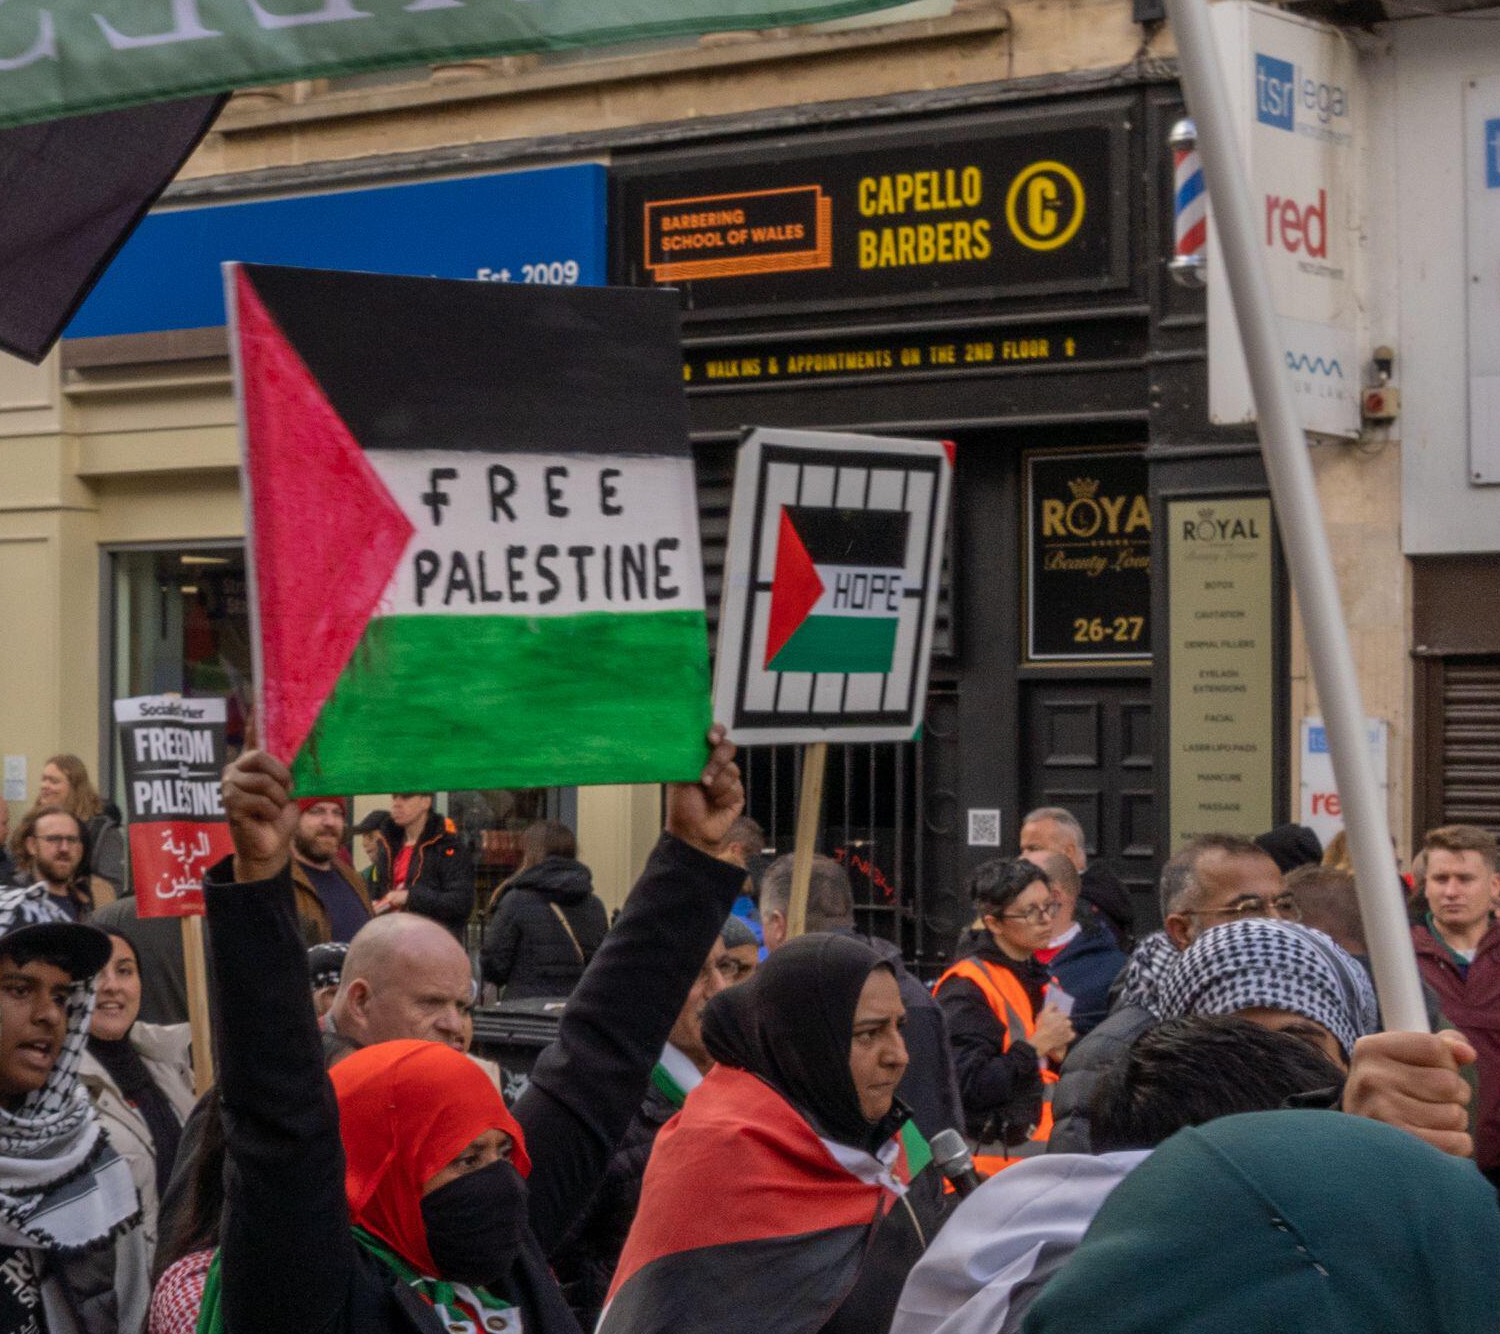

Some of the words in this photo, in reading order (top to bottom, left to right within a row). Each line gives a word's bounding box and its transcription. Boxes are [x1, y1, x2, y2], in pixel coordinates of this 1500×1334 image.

[858, 167, 982, 218] CAPELLO
[661, 209, 745, 231] BARBERING
[661, 232, 724, 251] SCHOOL
[727, 229, 749, 244] OF
[751, 224, 805, 243] WALES
[1265, 189, 1328, 259] red
[858, 219, 992, 269] BARBERS
[787, 350, 892, 373] APPOINTMENTS
[930, 345, 956, 364] THE
[964, 343, 993, 362] 2ND
[1002, 339, 1049, 359] FLOOR
[423, 464, 625, 526] FREE
[1042, 495, 1152, 537] ROYA
[1182, 518, 1260, 541] ROYAL
[414, 537, 681, 608] PALESTINE
[834, 575, 901, 611] HOPE
[1073, 616, 1144, 643] 26-27
[1204, 714, 1234, 724] FACIAL
